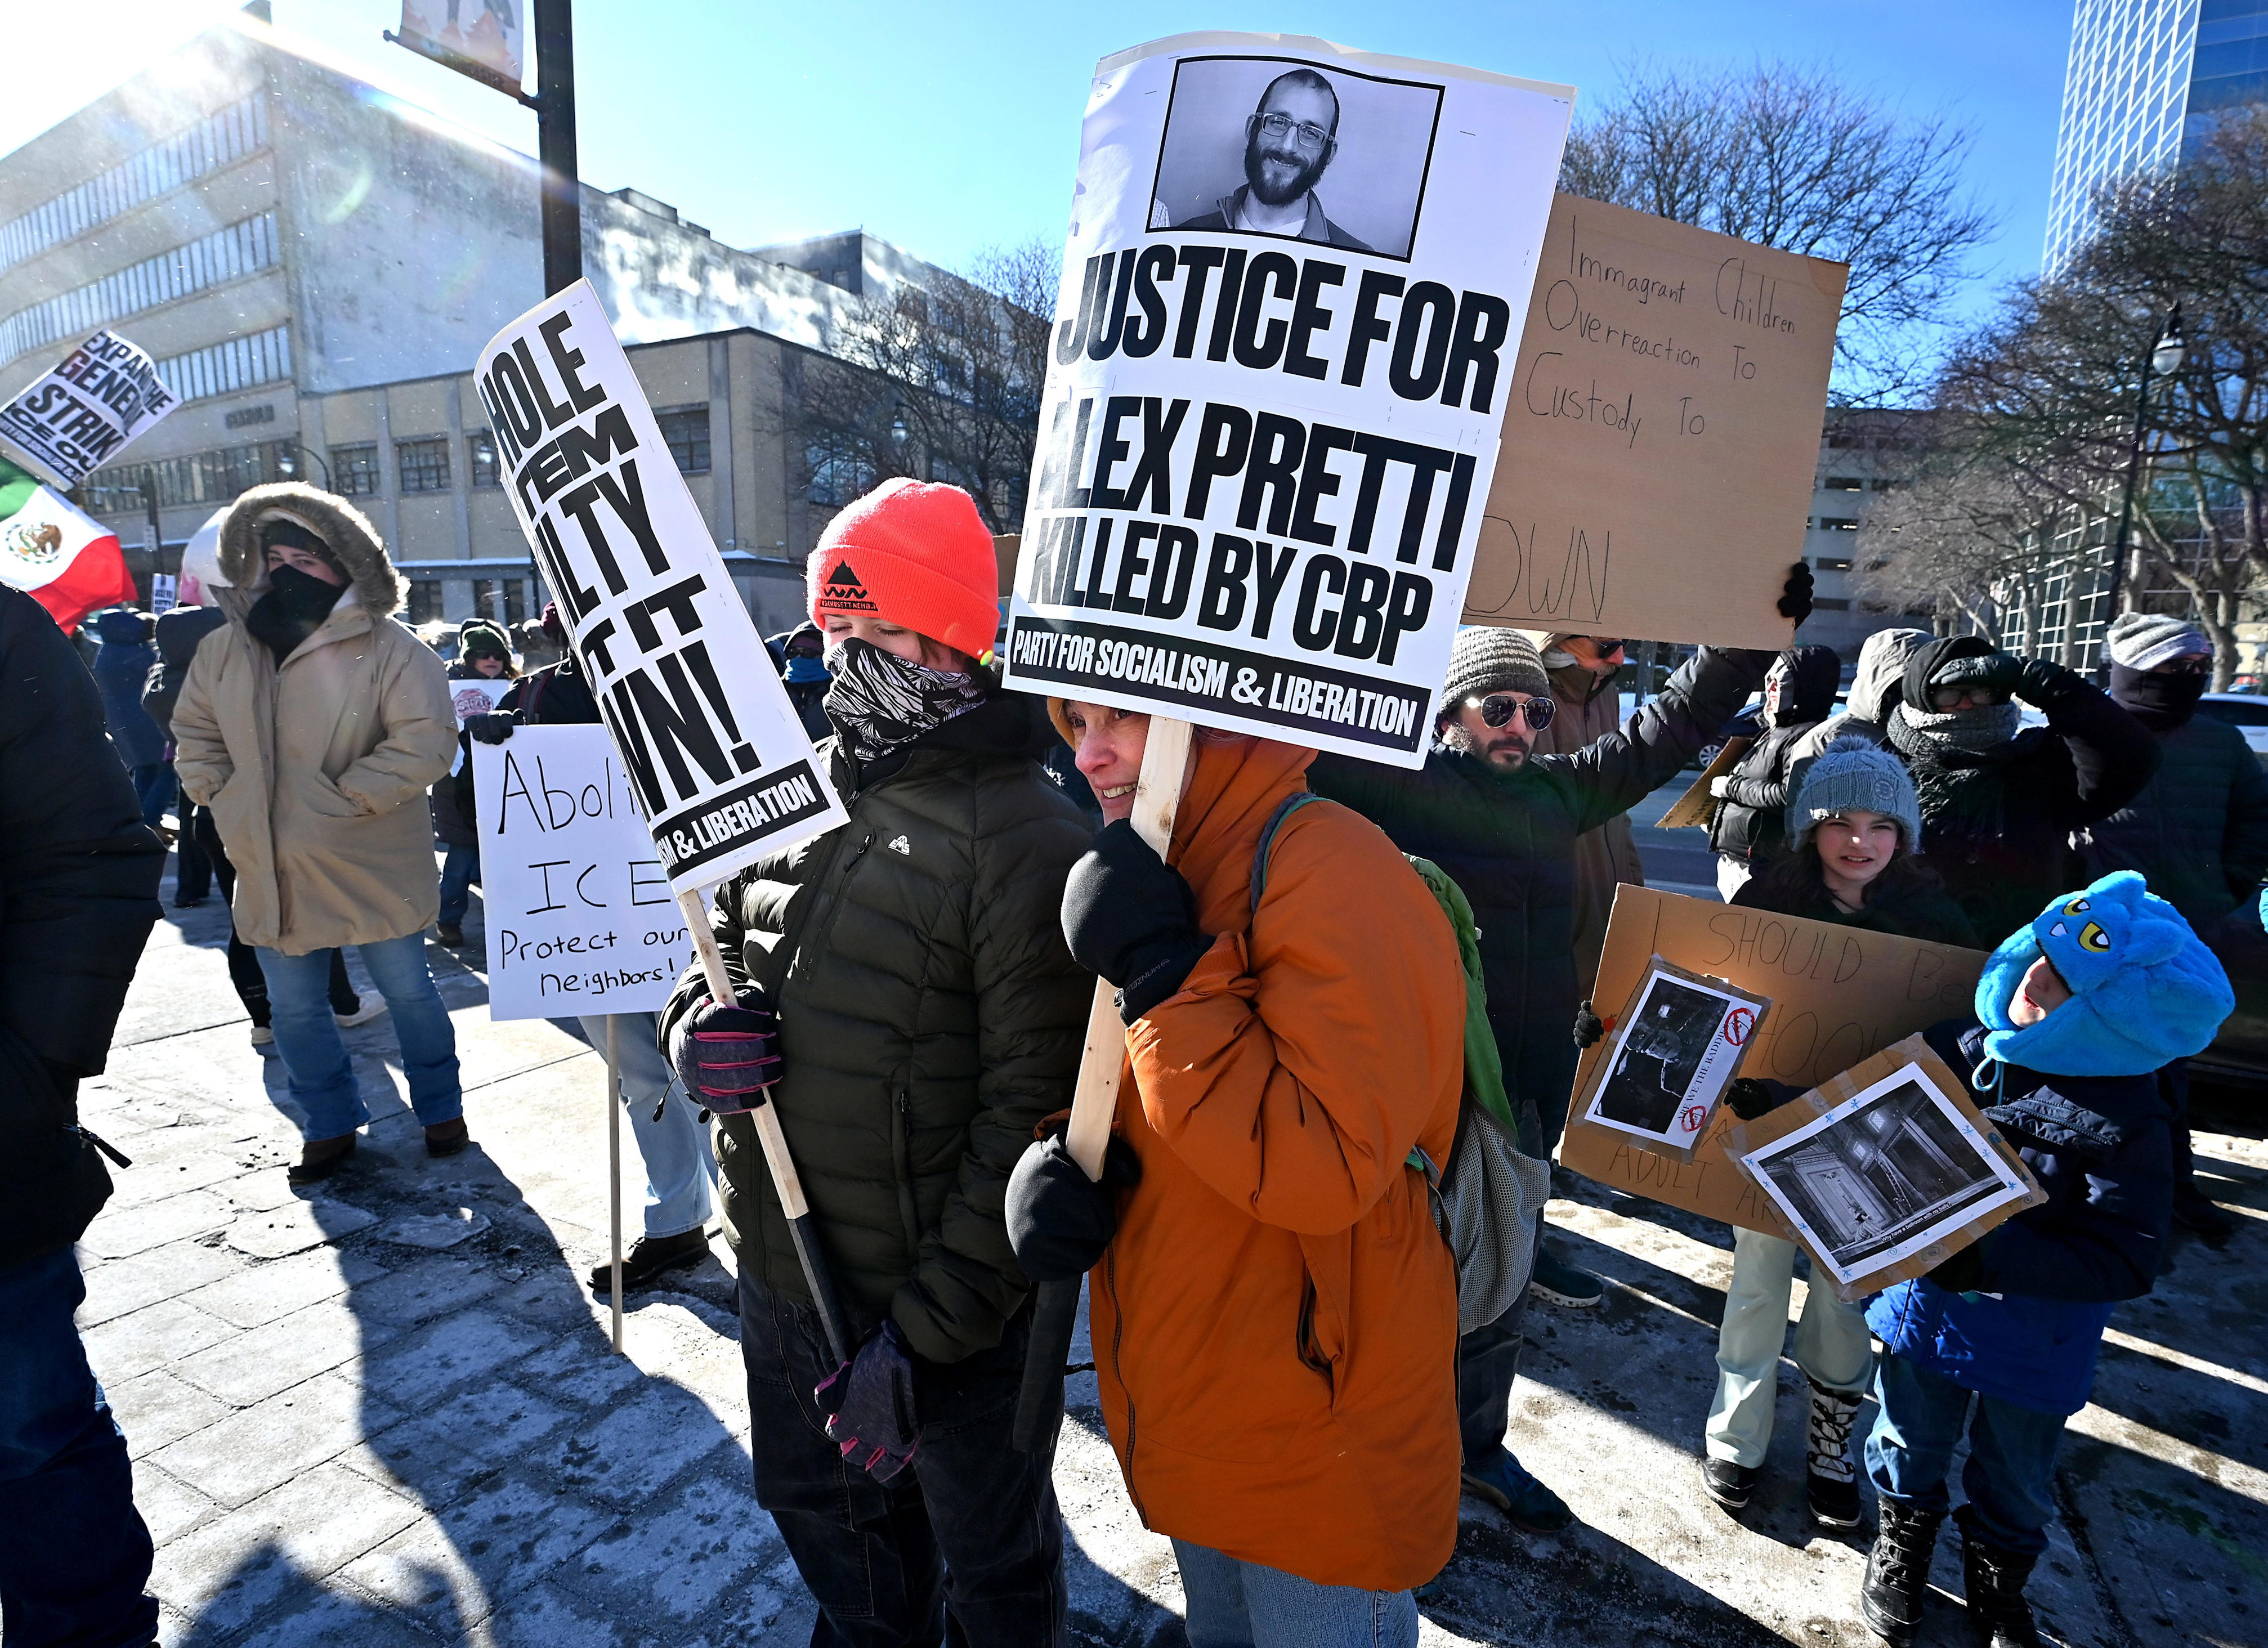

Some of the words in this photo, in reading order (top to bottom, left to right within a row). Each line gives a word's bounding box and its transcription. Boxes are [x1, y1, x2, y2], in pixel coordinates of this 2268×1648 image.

[1569, 215, 1685, 303] Immagrant
[1715, 257, 1795, 334] Children
[1055, 244, 1346, 380] JUSTICE
[1340, 270, 1510, 414] FOR
[1546, 279, 1700, 369] Overreaction
[1733, 345, 1756, 380] To
[25, 384, 125, 462] STRIK
[480, 310, 607, 474] HOLE
[1527, 352, 1642, 449] Custody
[1679, 397, 1705, 436] To
[56, 441, 97, 471] OU
[1035, 396, 1191, 515] ALEX
[1184, 403, 1477, 573] PRETTI
[1029, 516, 1198, 620] KILLED
[1198, 534, 1298, 640] BY
[1293, 553, 1433, 666] CBP
[1465, 516, 1609, 621] OWN
[623, 574, 707, 654] IT
[1013, 629, 1059, 668] PARTY
[1057, 634, 1096, 674] FOR
[1096, 639, 1229, 698] SOCIALISM
[1231, 668, 1265, 706] &
[1268, 671, 1417, 737] LIBERATION
[498, 751, 636, 834] Aboli
[673, 830, 700, 859] &
[691, 773, 817, 850] LIBERATION
[527, 861, 672, 915] ICE
[501, 930, 618, 969] Protect
[643, 928, 688, 947] our
[540, 958, 676, 997] neighbors!
[1703, 913, 1862, 984] SHOULD
[1687, 1086, 1699, 1101] WE
[1694, 1065, 1710, 1087] THE
[1891, 1229, 1902, 1237] have
[1905, 1217, 1924, 1229] ballroom
[1939, 1202, 1953, 1212] balls?
